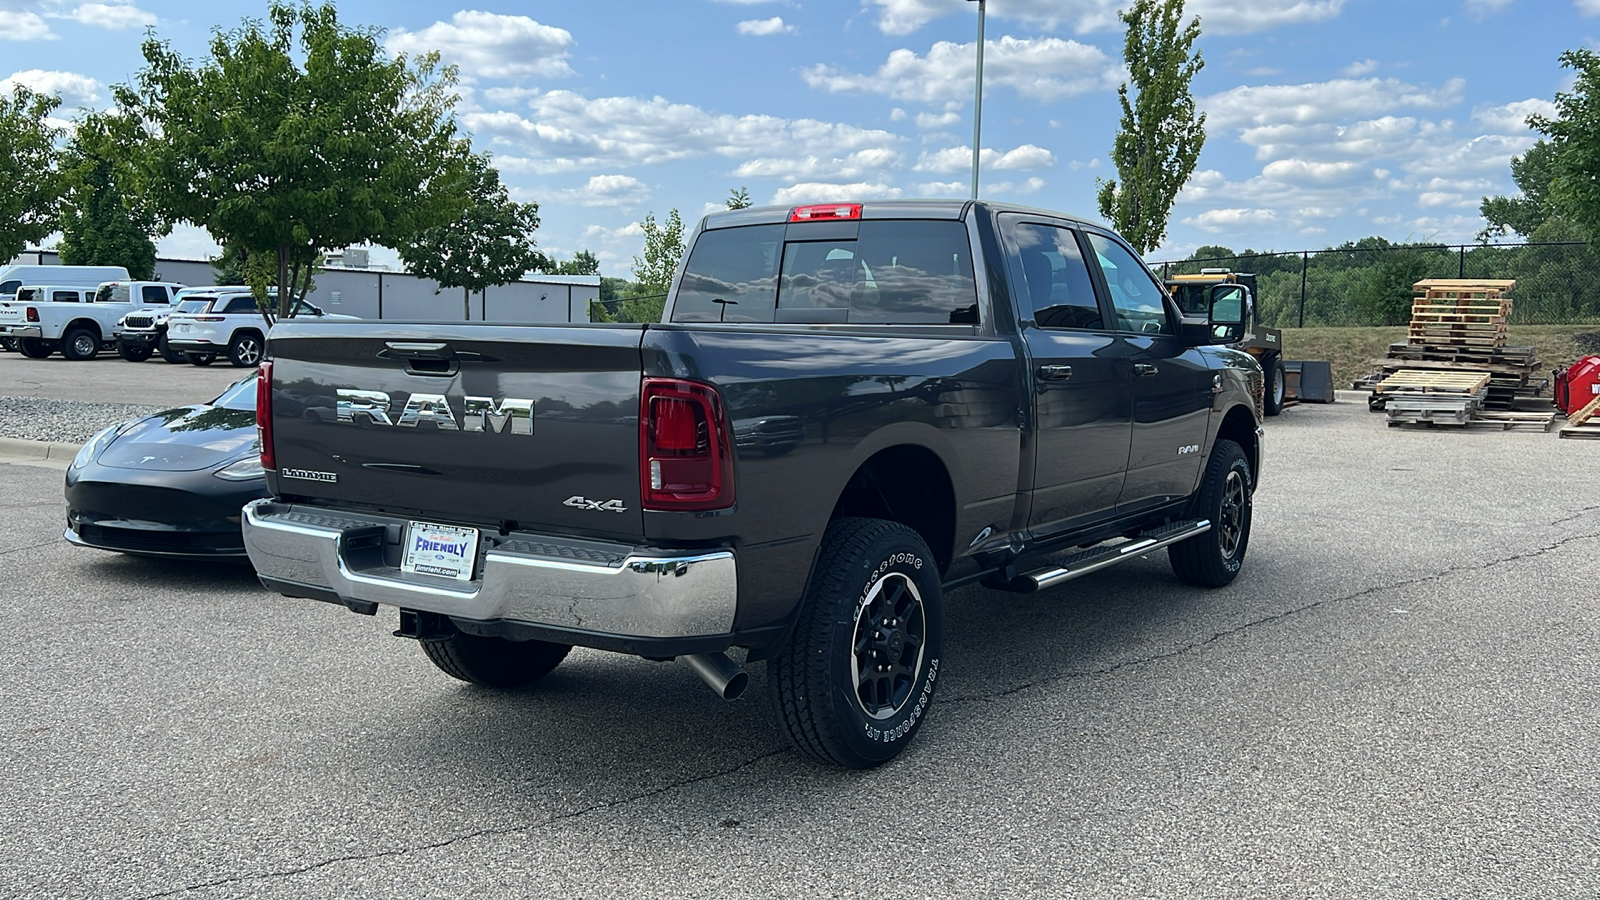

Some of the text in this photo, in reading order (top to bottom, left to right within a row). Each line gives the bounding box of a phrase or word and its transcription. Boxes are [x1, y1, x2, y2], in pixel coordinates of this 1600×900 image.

[336, 388, 535, 436] RAM
[1177, 444, 1199, 455] RAM
[282, 467, 337, 483] LARAMIE
[415, 535, 468, 558] FRIENDLY
[415, 564, 457, 577] jimriehl.com
[883, 658, 939, 743] TRANSFORCE
